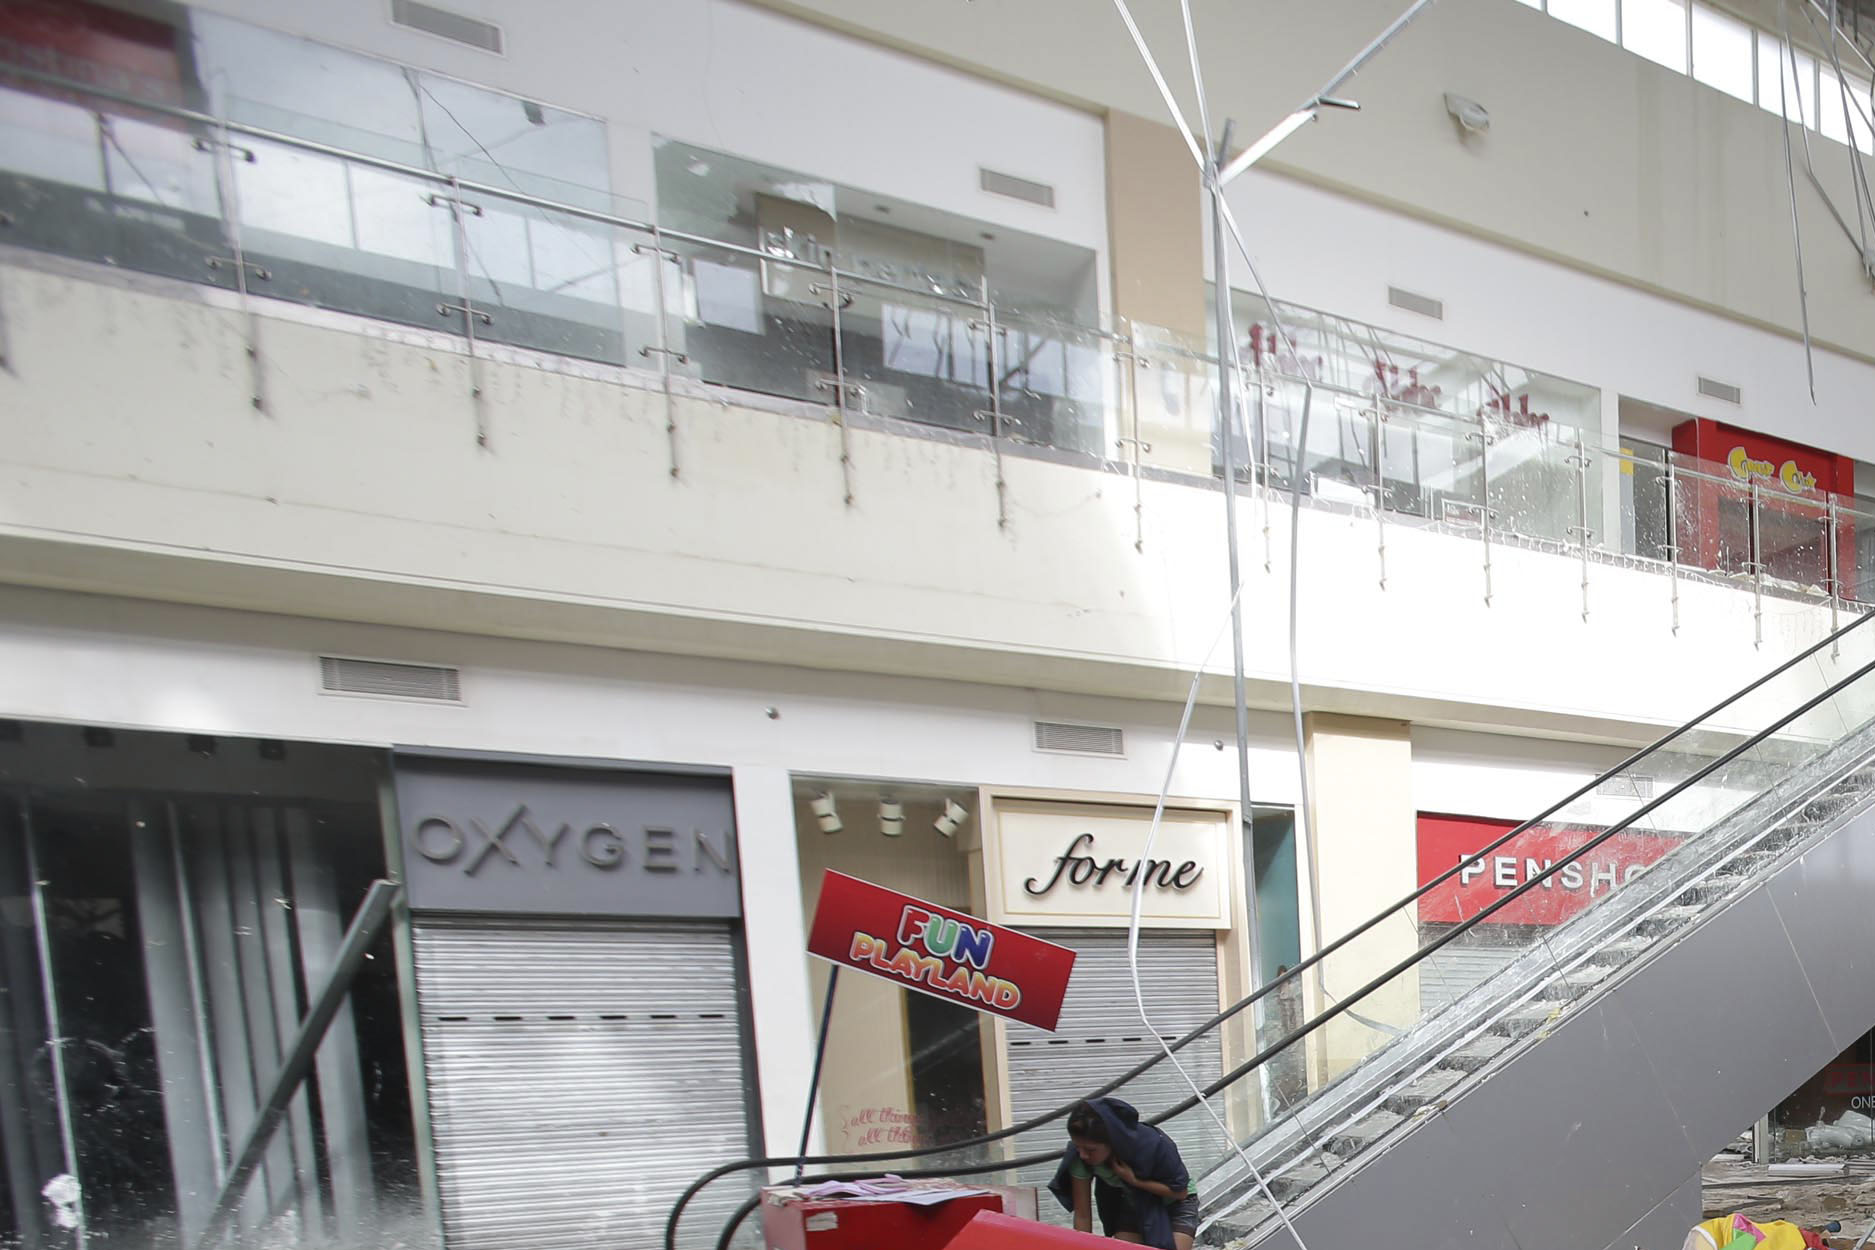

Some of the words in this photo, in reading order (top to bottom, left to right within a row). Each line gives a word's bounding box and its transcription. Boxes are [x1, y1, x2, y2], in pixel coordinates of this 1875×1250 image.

[414, 804, 735, 877] OXYGEN
[850, 932, 1022, 1010] PLAYLAND
[897, 905, 993, 968] FUN
